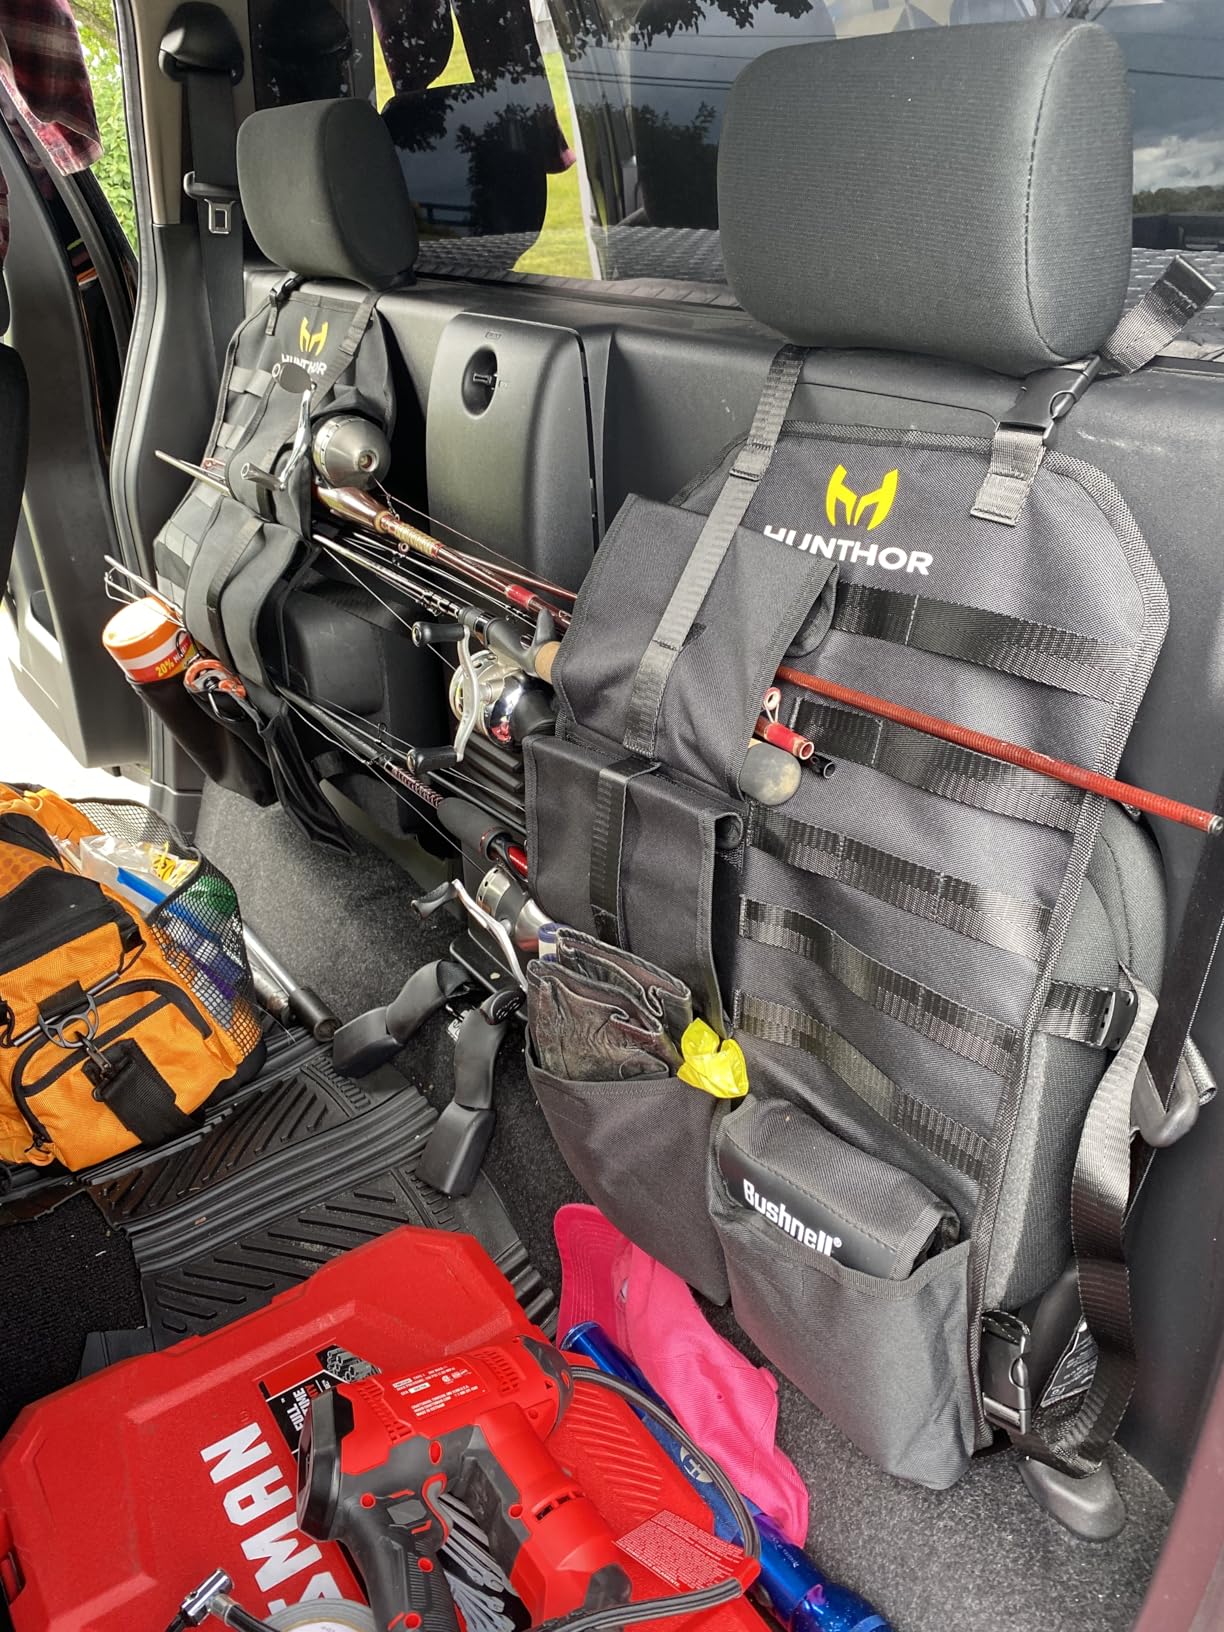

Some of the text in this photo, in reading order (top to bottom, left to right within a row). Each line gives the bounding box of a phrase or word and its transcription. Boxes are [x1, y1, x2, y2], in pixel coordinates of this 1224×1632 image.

[763, 524, 934, 576] HUNTHOR
[155, 657, 175, 678] 20%
[286, 1402, 305, 1431] FULL
[200, 1421, 343, 1616] MAN
